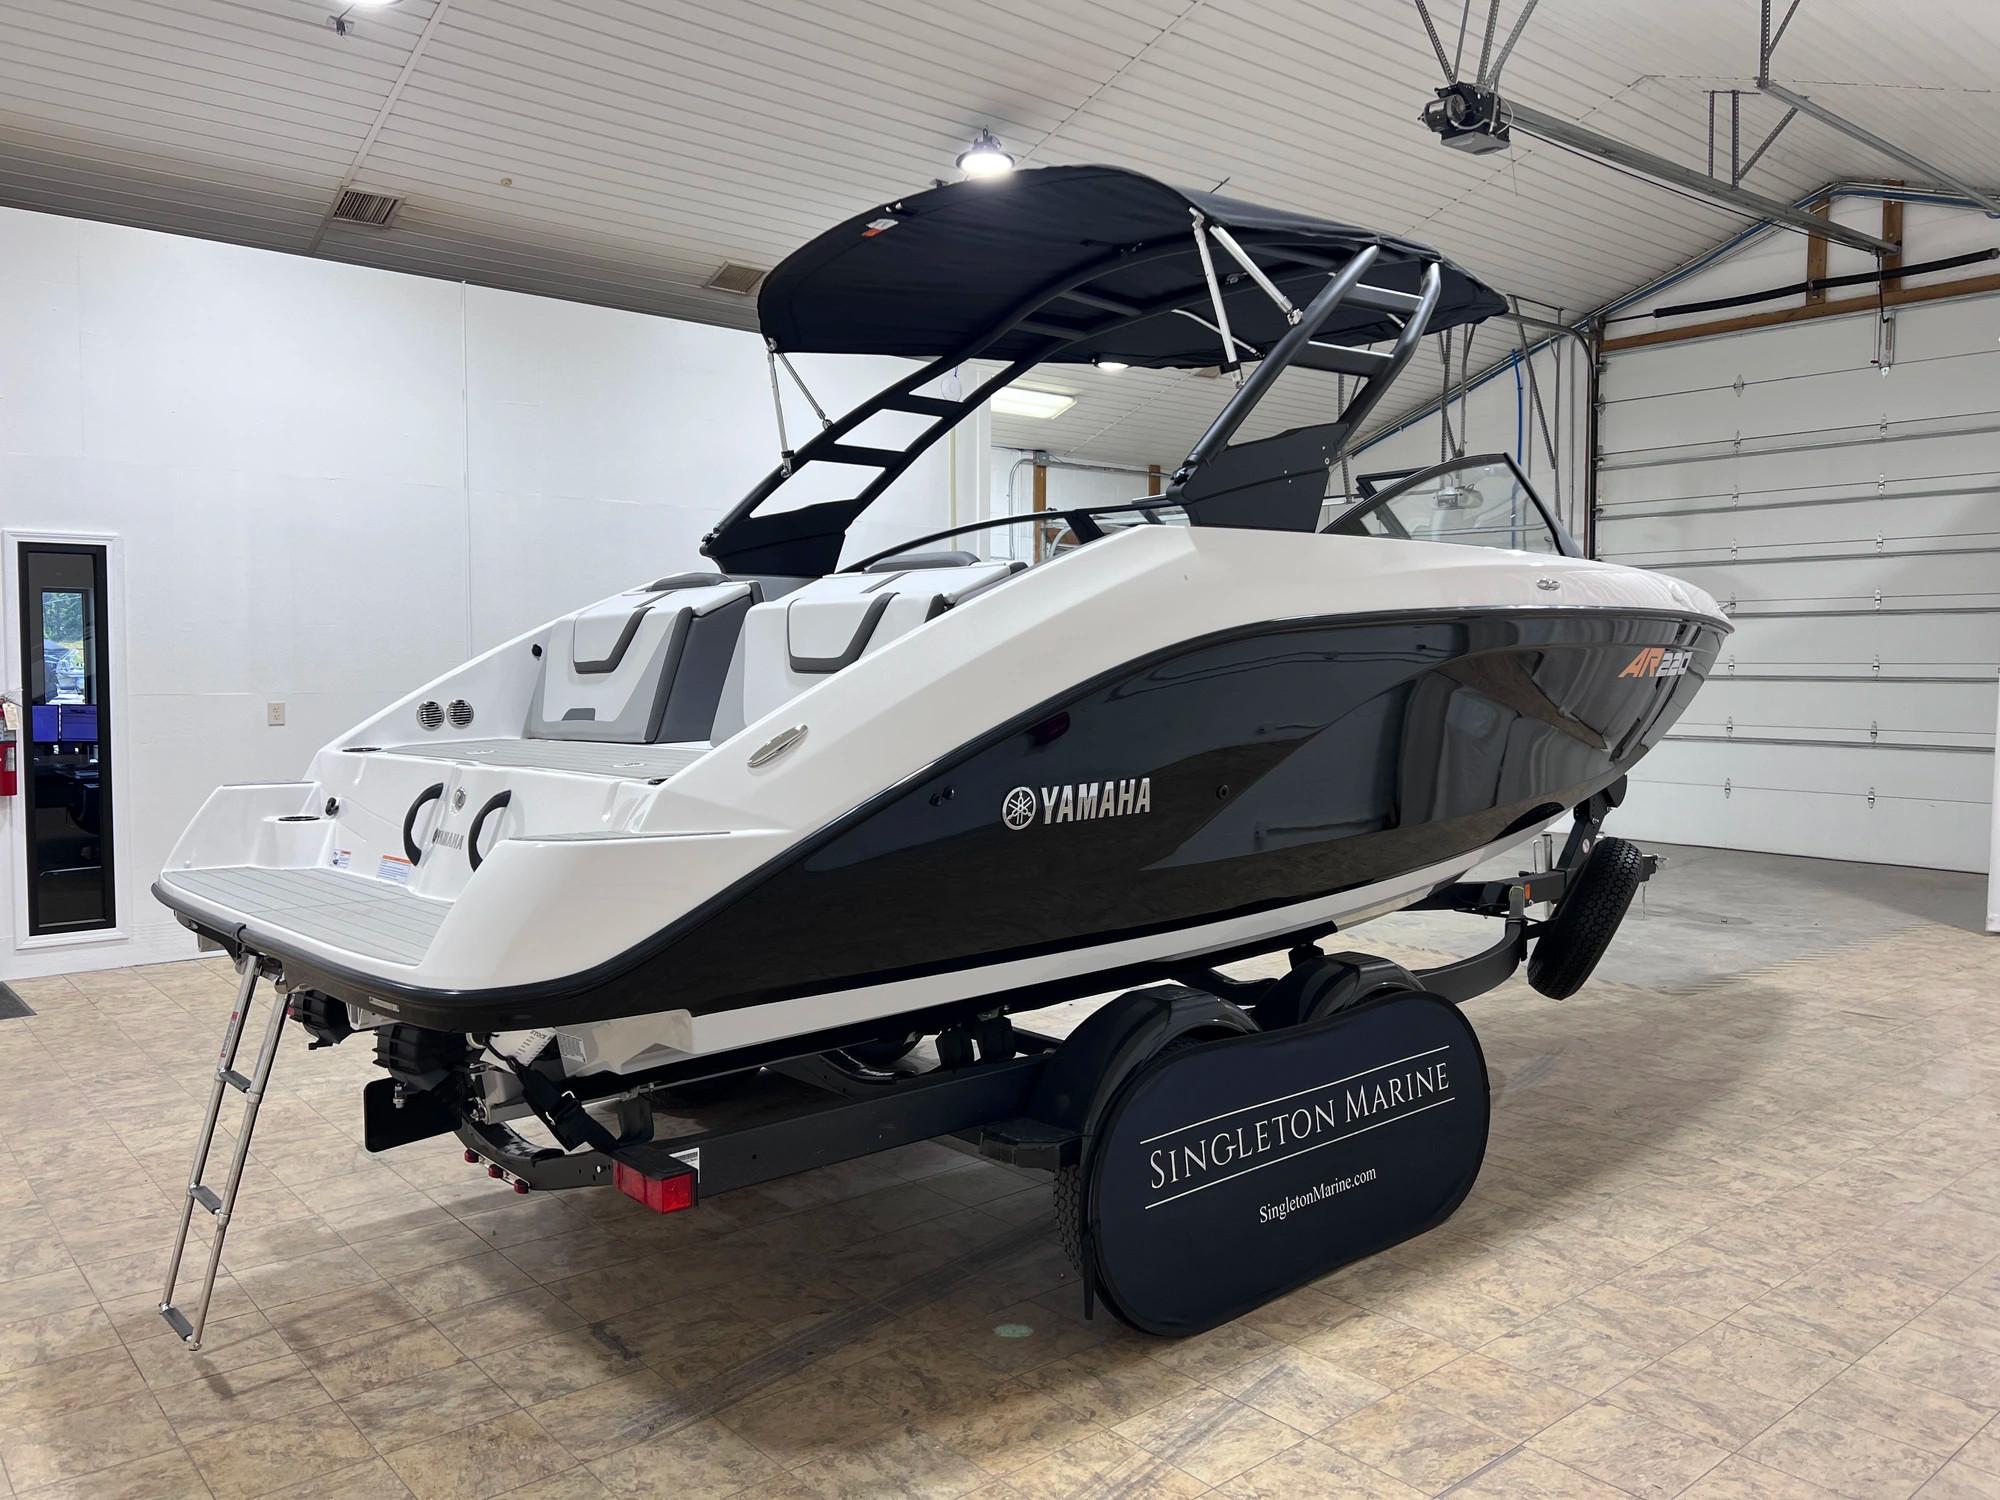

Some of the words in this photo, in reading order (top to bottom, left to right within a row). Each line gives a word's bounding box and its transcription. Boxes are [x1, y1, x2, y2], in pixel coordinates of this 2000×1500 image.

[1617, 647, 1693, 678] AR220
[1041, 778, 1150, 824] YAMAHA
[1150, 1100, 1336, 1189] SINGLETON
[1345, 1062, 1449, 1123] MARINE
[1259, 1166, 1377, 1223] SingletonMarine.com
